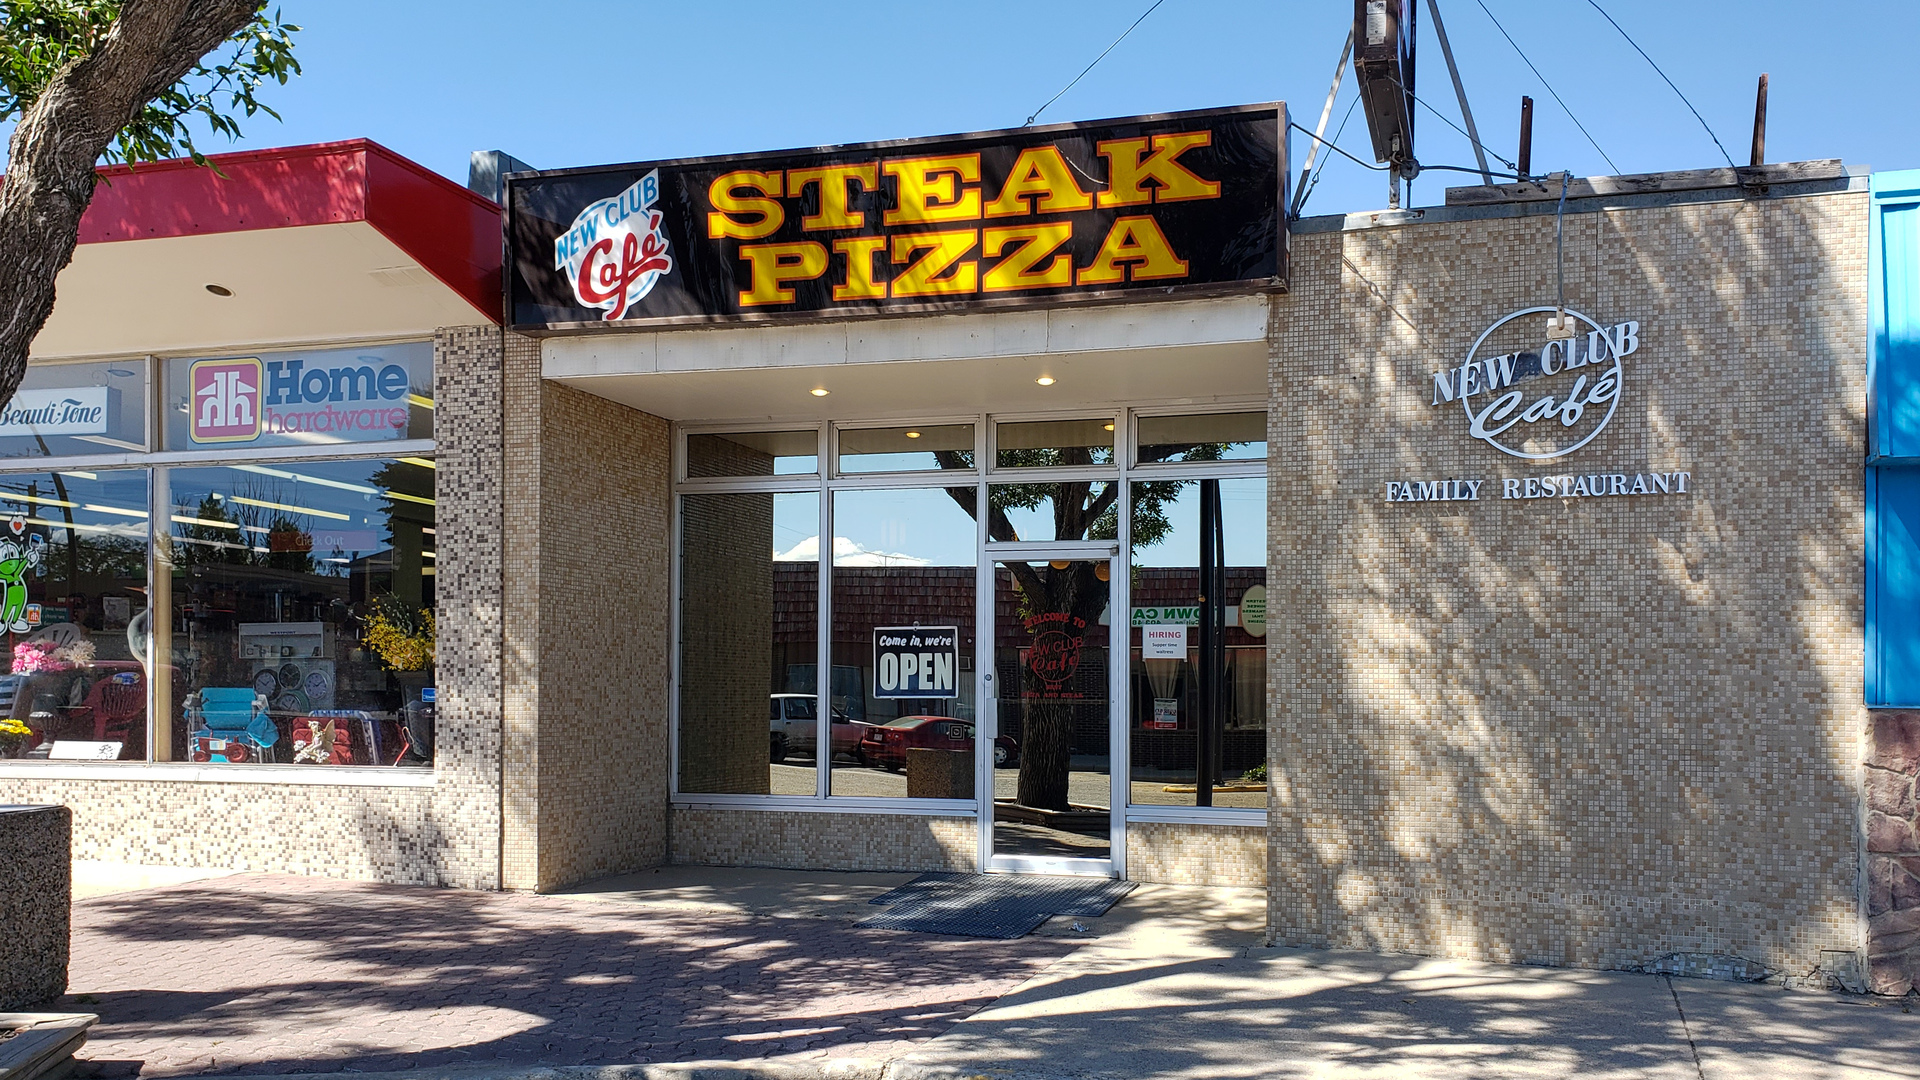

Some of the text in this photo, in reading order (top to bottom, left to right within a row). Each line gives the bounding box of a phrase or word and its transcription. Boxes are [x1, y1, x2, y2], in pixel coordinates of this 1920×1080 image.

[708, 130, 1222, 239] STEAK
[557, 176, 658, 265] NEW CLUB
[577, 214, 669, 320] Café
[739, 214, 1189, 307] PIZZA
[266, 360, 408, 405] Home
[1431, 320, 1639, 406] NEW CLUB
[265, 405, 407, 434] hardware
[1469, 366, 1620, 439] Café
[1384, 472, 1691, 502] FAMILY RESTAURANT
[324, 535, 344, 546] Out
[1022, 613, 1086, 629] WELCOME TO
[1148, 631, 1181, 639] HIRING
[879, 635, 952, 647] Come in, we're
[1053, 636, 1083, 652] CLUB
[879, 652, 953, 691] OPEN
